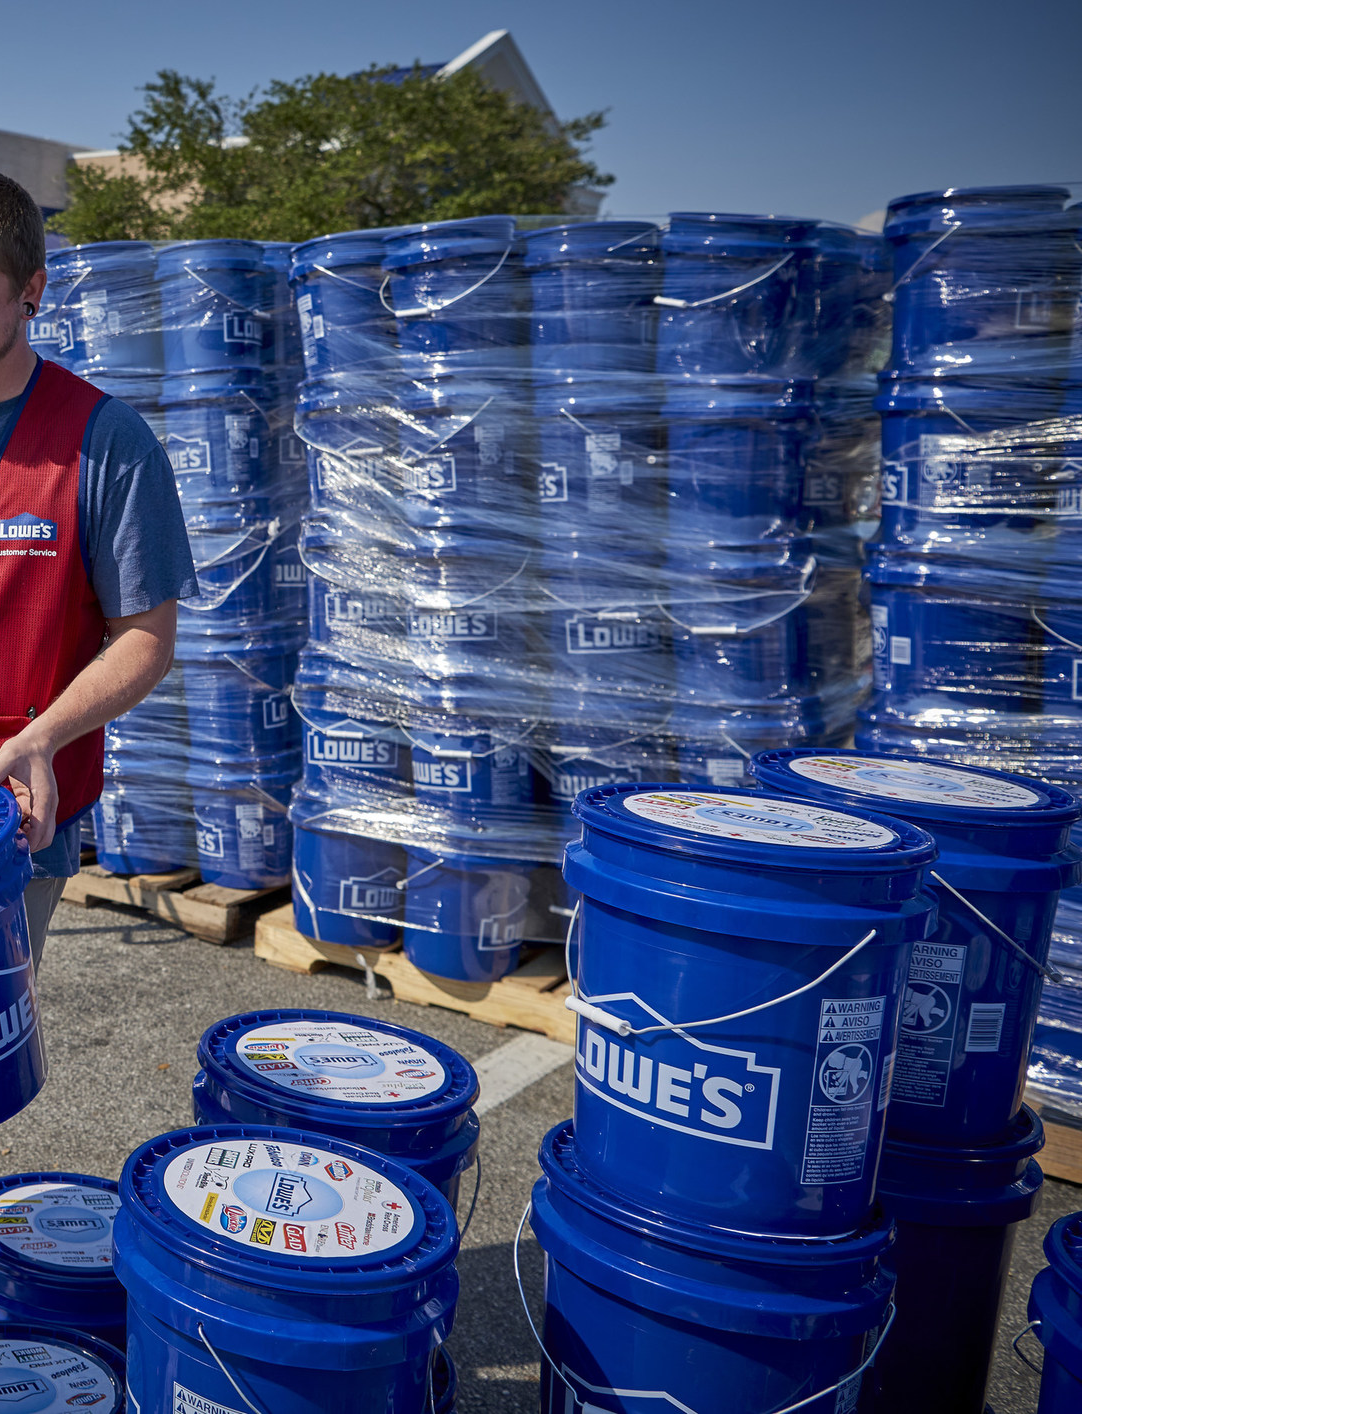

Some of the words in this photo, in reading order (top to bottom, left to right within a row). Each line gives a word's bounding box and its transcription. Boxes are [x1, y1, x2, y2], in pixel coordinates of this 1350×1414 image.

[0, 522, 52, 539] LOWE'S
[29, 549, 57, 557] Service
[578, 623, 650, 648] LOWE
[314, 739, 390, 763] LOWE'S
[413, 760, 461, 786] WE'S
[351, 884, 395, 909] LOW
[913, 944, 958, 957] ARNING
[908, 969, 959, 983] ERTISSEMENT
[838, 1001, 880, 1013] WARNING
[842, 1015, 869, 1027] AVISO
[835, 1028, 879, 1042] AVERTISSEMENT
[248, 1043, 286, 1051] Quickie
[378, 1045, 416, 1057] Fabuloso
[259, 1062, 293, 1070] GLAD
[310, 1055, 369, 1065] LOWE'S
[290, 1078, 331, 1086] Cutter
[249, 1143, 257, 1156] LUX
[243, 1155, 253, 1168] PRO
[272, 1176, 300, 1212] LOWE'S
[46, 1220, 98, 1228] LOWE'S
[226, 1204, 246, 1233] Quickie
[391, 1213, 401, 1235] American
[0, 1226, 31, 1234] GLAD
[381, 1219, 390, 1233] Cross
[285, 1225, 304, 1252] GLAD
[335, 1221, 356, 1251] Cutter
[14, 1346, 45, 1356] WORKS
[18, 1352, 50, 1363] SAFETY
[51, 1361, 90, 1380] Fabuloso
[68, 1377, 99, 1390] DAWN
[70, 1392, 101, 1406] CLOROX
